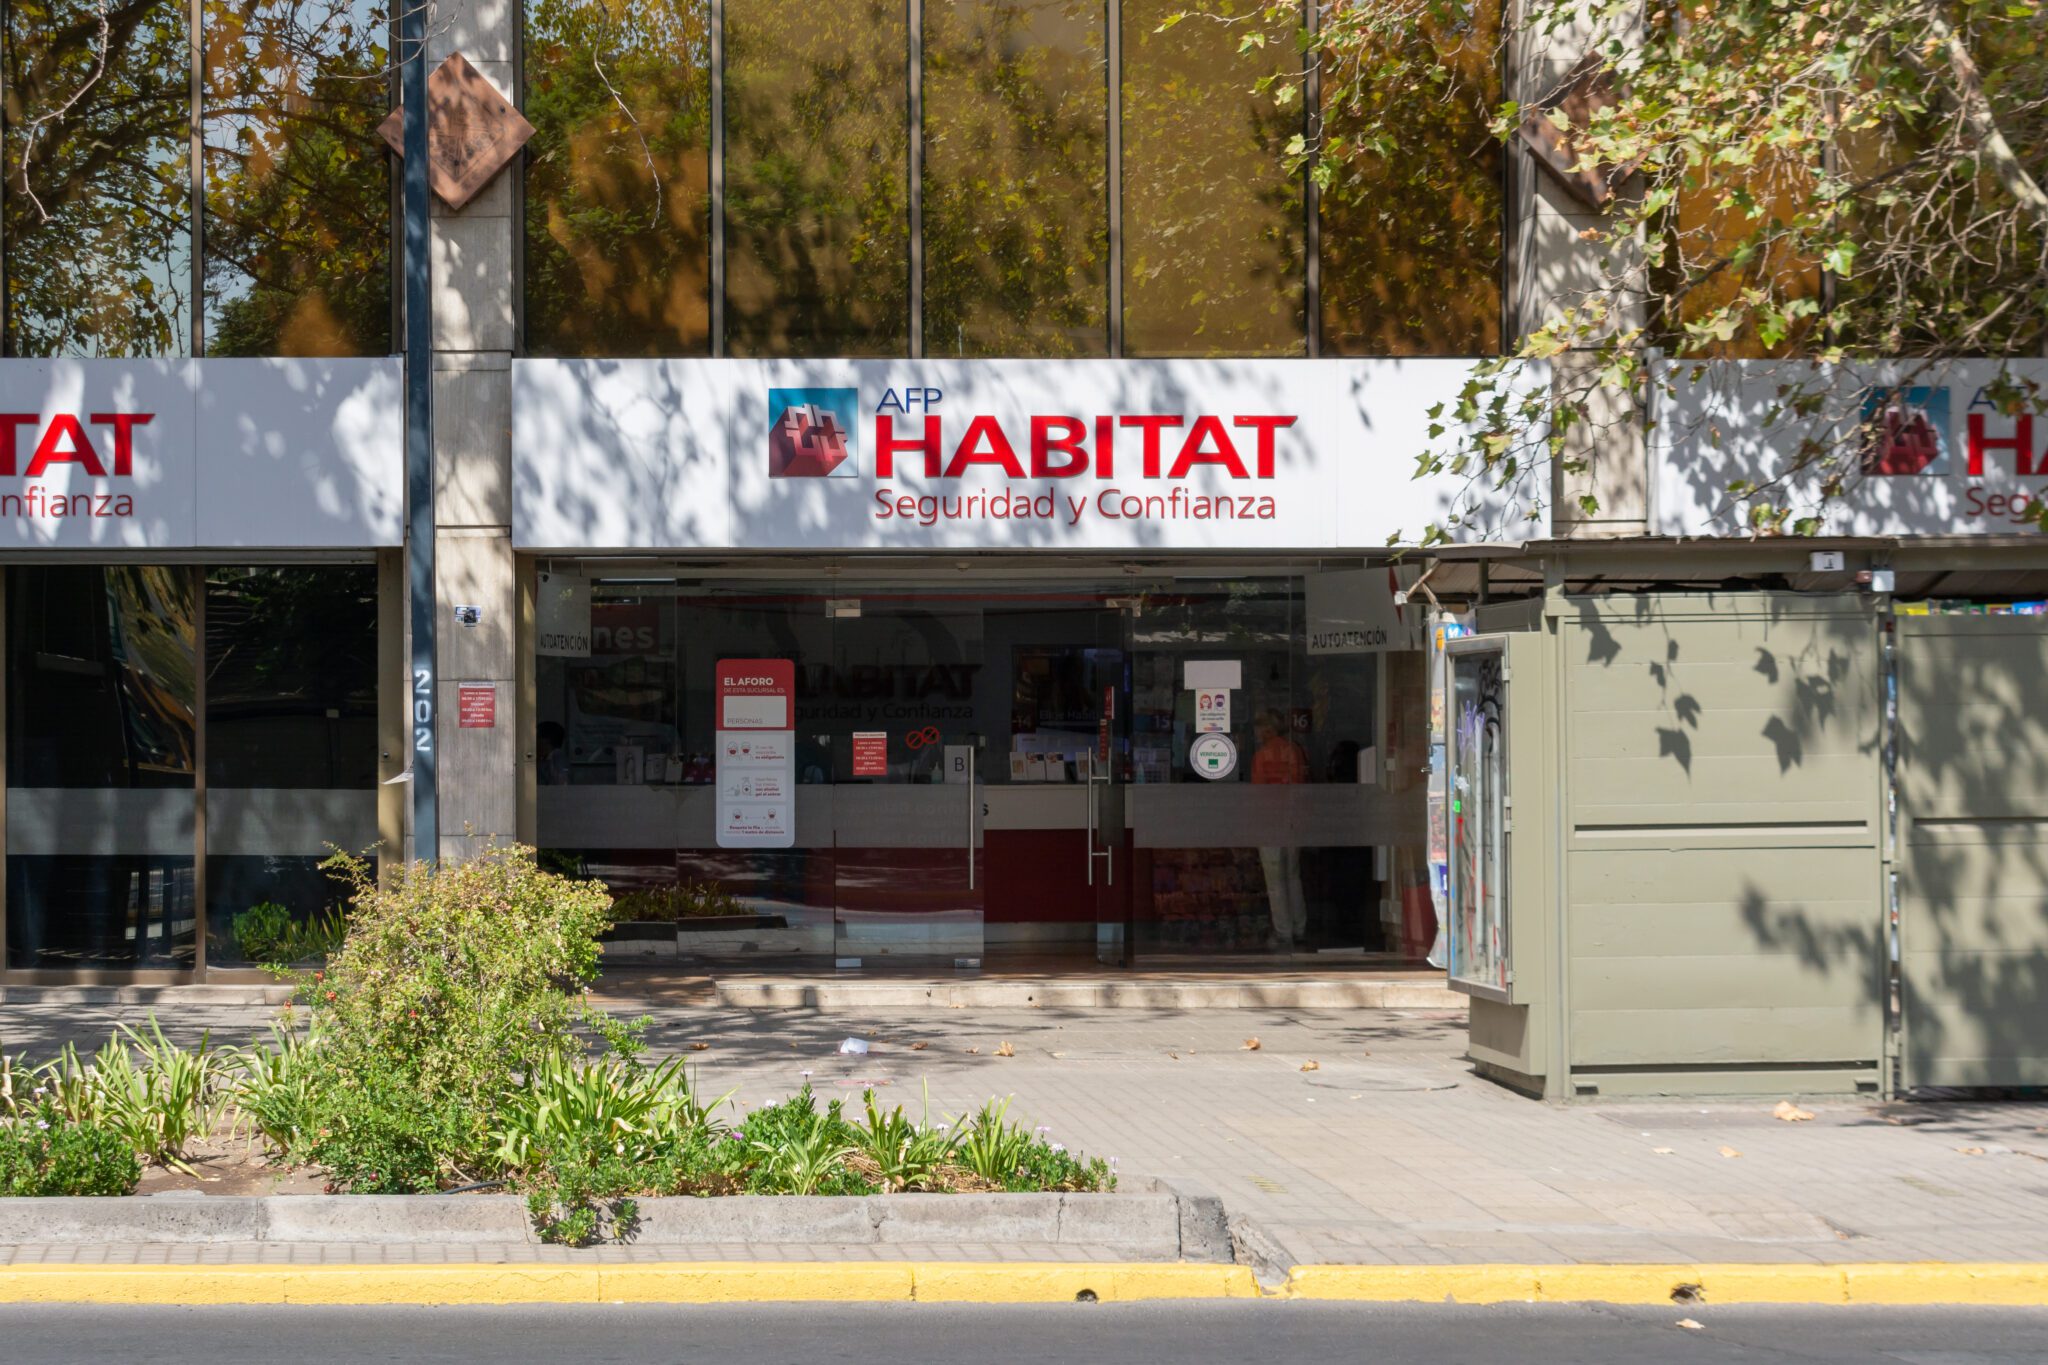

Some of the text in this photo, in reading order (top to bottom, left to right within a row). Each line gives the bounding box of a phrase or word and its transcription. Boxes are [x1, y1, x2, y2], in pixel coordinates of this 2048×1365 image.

[876, 387, 944, 414] AFP
[0, 413, 155, 476] TAT
[876, 415, 1298, 479] HABITAT
[1967, 413, 2048, 475] H
[2, 486, 133, 518] nfianza
[875, 487, 1277, 527] Seguridad y Confianza
[540, 632, 589, 651] AUTOATENCIÓN
[1311, 626, 1388, 649] AUTOATENCIÓN
[723, 677, 774, 686] EL AFORO
[795, 702, 862, 721] guridad
[883, 702, 973, 719] Confianza
[1154, 714, 1170, 729] 15
[1292, 714, 1308, 728] 16
[954, 757, 965, 772] B
